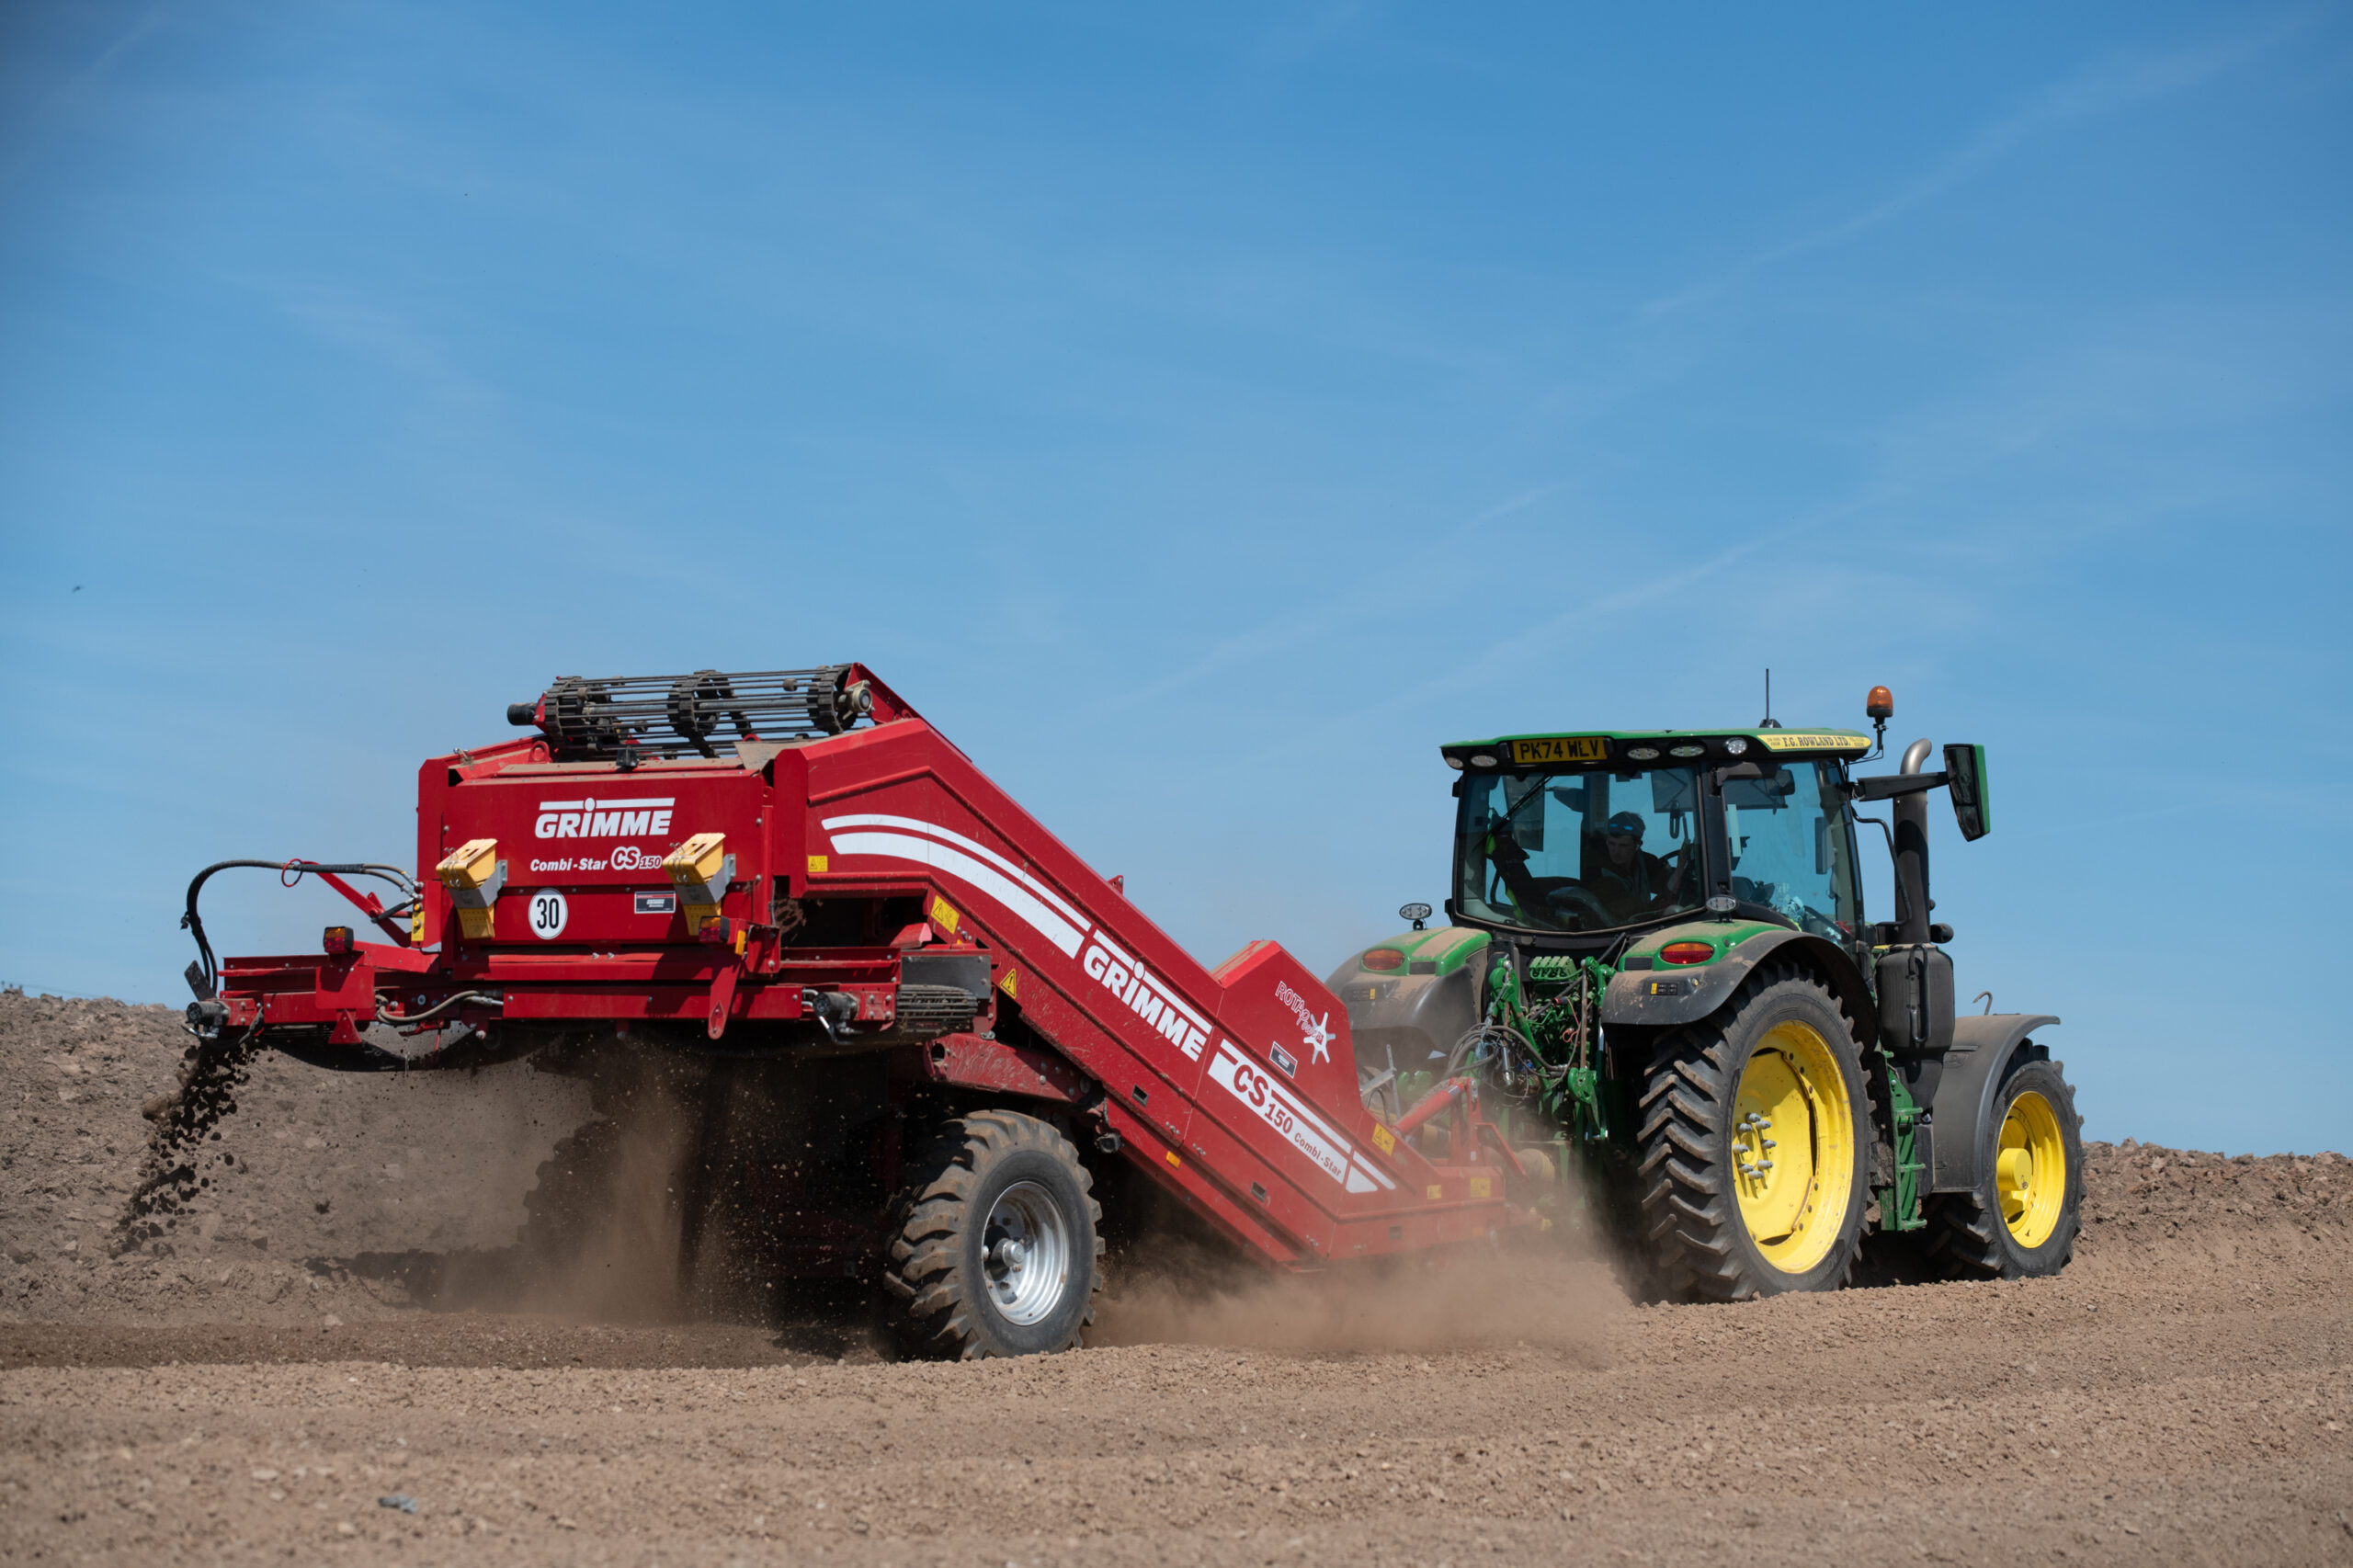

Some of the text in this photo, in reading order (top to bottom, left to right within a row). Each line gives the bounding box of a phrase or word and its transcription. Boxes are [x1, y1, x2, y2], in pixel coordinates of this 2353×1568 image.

[1519, 739, 1598, 760] PK74 WLV
[1798, 736, 1835, 746] ROWLAND
[535, 798, 674, 838] GRIMME
[611, 846, 641, 870] CS
[639, 856, 663, 869] 150
[537, 898, 559, 929] 30
[1084, 945, 1207, 1062] GRIMME
[1233, 1064, 1268, 1108] CS
[1264, 1104, 1293, 1134] 150
